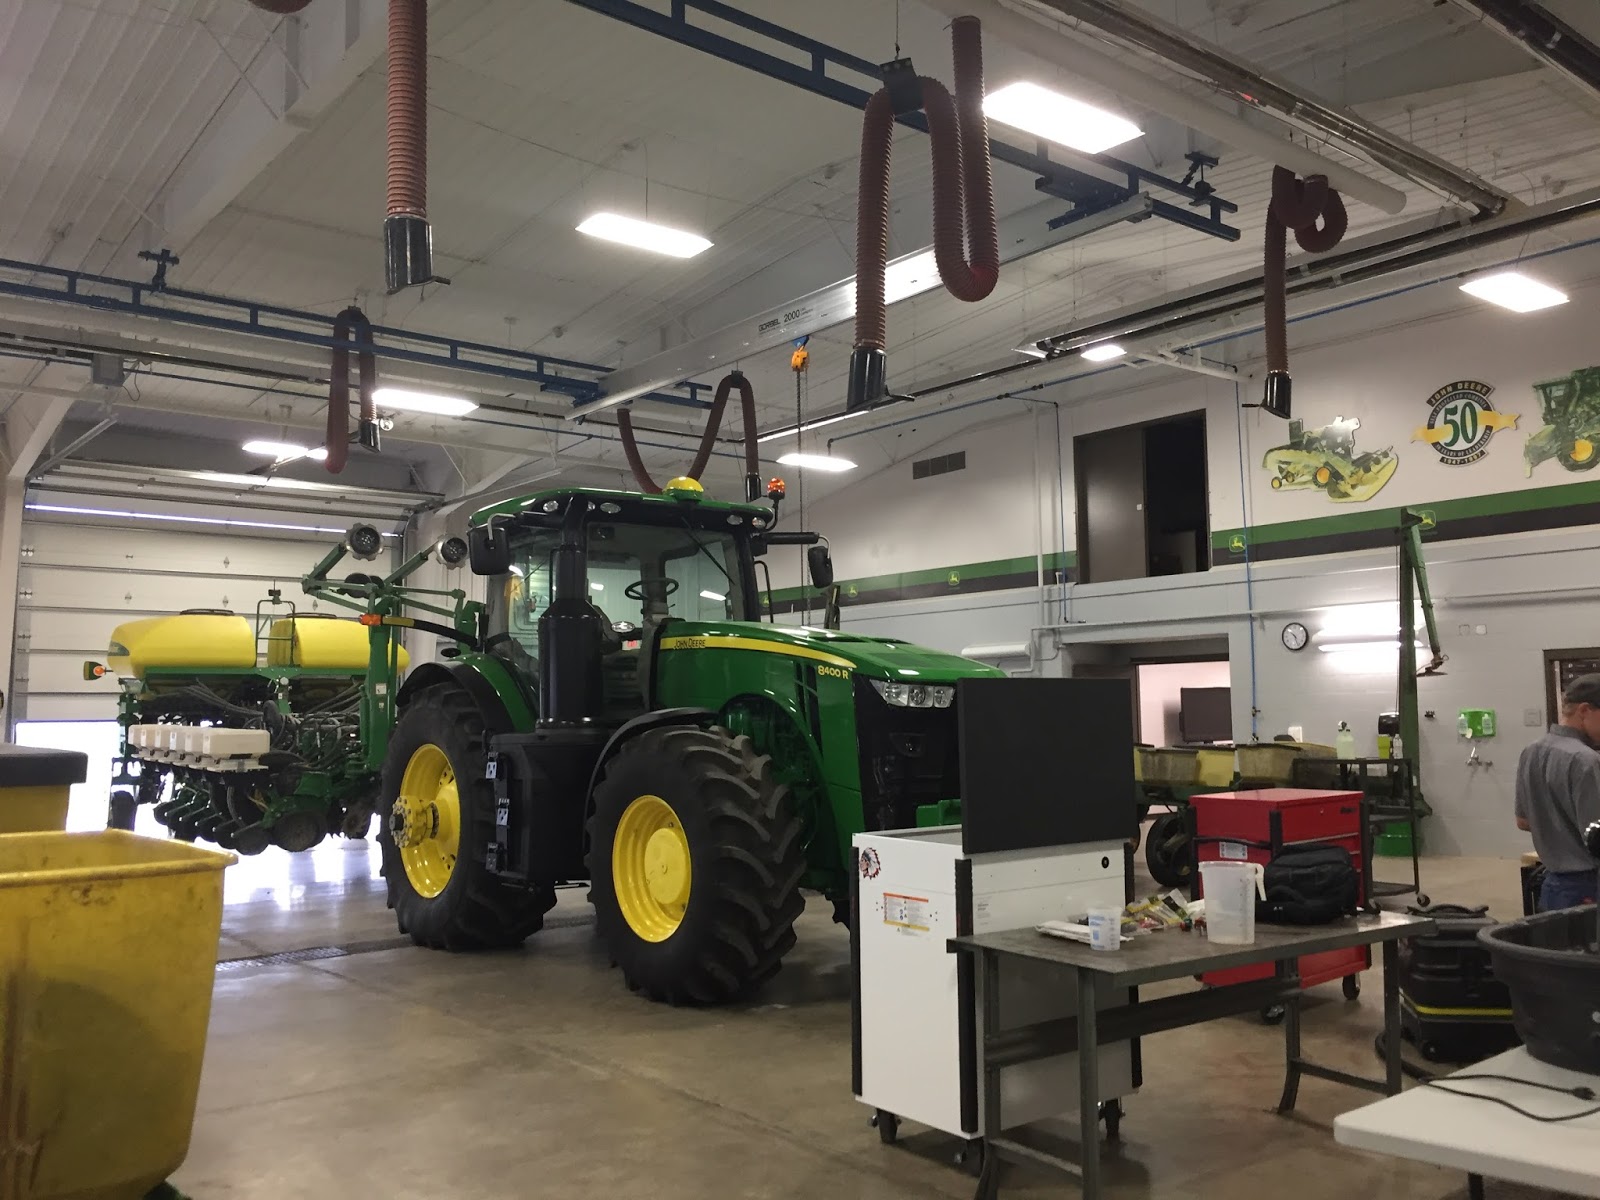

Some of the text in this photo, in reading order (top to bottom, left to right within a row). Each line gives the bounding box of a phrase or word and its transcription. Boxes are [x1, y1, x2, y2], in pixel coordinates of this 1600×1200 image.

[784, 309, 800, 322] 2000
[1430, 382, 1488, 404] JOHN DEERE
[1444, 401, 1477, 447] 50
[674, 638, 705, 649] JOHN DEERE
[817, 665, 849, 679] 8400 R
